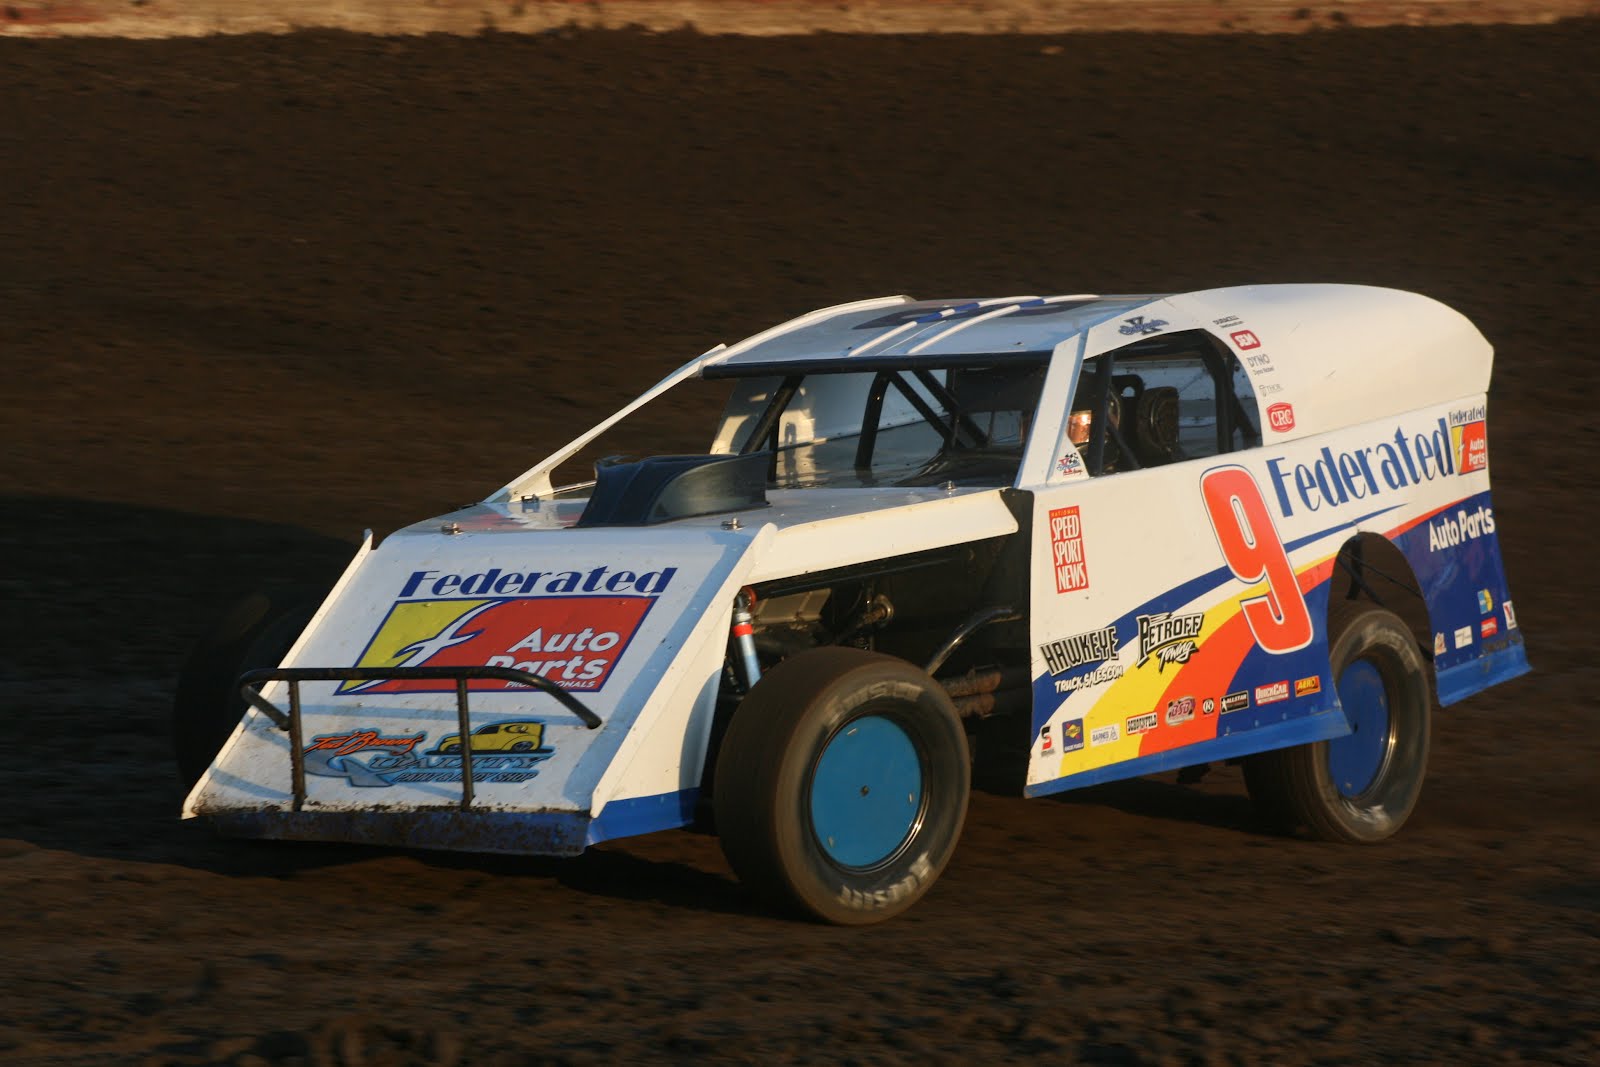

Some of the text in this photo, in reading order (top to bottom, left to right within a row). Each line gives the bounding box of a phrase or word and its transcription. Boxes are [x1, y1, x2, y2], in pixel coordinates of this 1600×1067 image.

[1246, 353, 1270, 367] DYNO
[1270, 409, 1293, 427] CRC
[1449, 405, 1485, 425] Federated
[1470, 438, 1485, 450] Auto
[1266, 418, 1454, 517] Federated
[1468, 451, 1486, 466] Parts
[1051, 515, 1080, 541] SPEED
[1429, 506, 1496, 552] Auto Parts
[1054, 538, 1082, 566] SPORT
[1200, 464, 1314, 655] 9
[398, 565, 679, 598] Federated
[1057, 562, 1086, 591] NEWS
[506, 627, 620, 653] Auto
[1039, 626, 1119, 676] HAWKEYE
[1137, 613, 1204, 669] PETROFF
